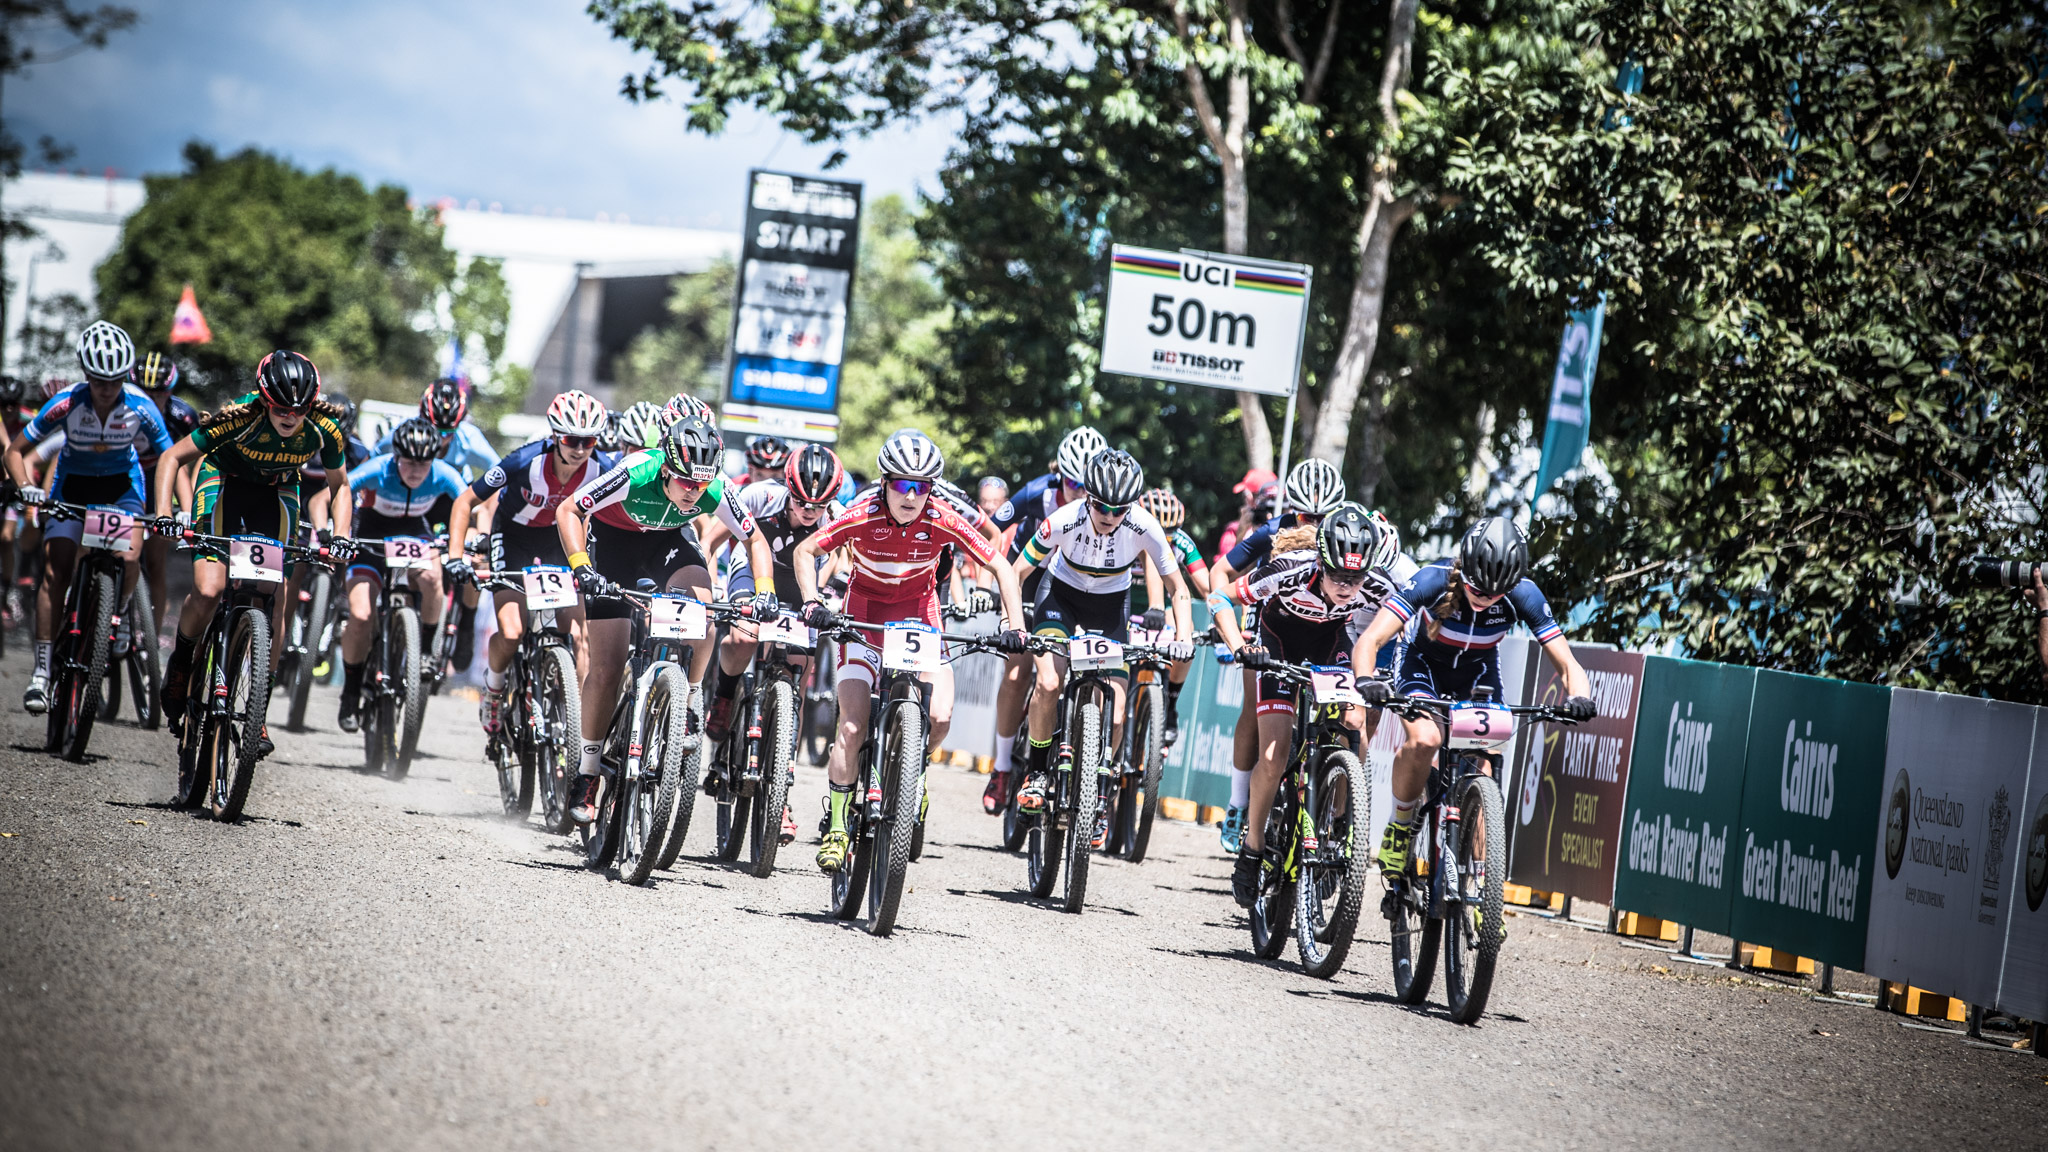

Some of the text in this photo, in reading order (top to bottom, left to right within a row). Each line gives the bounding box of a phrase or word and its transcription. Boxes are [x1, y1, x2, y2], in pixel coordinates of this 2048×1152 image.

[757, 221, 846, 256] START
[1184, 262, 1230, 287] UCI
[1147, 293, 1257, 349] 50m
[1179, 352, 1245, 373] TISSOT
[208, 423, 235, 439] SOUTH
[310, 410, 334, 432] SOUTH
[71, 429, 132, 440] ARGENTINA
[236, 443, 273, 462] SOUTH
[196, 491, 206, 521] SOUTH
[98, 513, 121, 534] 19
[1121, 519, 1148, 536] antini
[240, 536, 274, 545] SHIMANO
[395, 542, 422, 558] 28
[957, 523, 994, 557] postnord
[249, 545, 265, 566] 8
[867, 550, 898, 558] postnord
[671, 601, 687, 621] 7
[777, 617, 792, 633] 4
[894, 622, 932, 633] SHIMANO
[905, 632, 921, 654] 5
[1083, 640, 1109, 655] 16
[1333, 673, 1350, 690] 2
[1461, 702, 1501, 710] SHIMANO
[1473, 710, 1490, 736] 3
[1562, 730, 1624, 784] PARTY HIRE
[1663, 700, 1713, 794] Cairns
[1780, 718, 1838, 820] Cairns
[1572, 792, 1599, 826] EVENT
[1913, 787, 1964, 830] Queensland
[1561, 832, 1605, 871] SPECIALIST
[1629, 808, 1728, 889] Great Barrier Reef
[1909, 834, 1970, 878] national parks
[1742, 832, 1861, 923] Great Barrier Reef
[1905, 882, 1917, 906] keep
